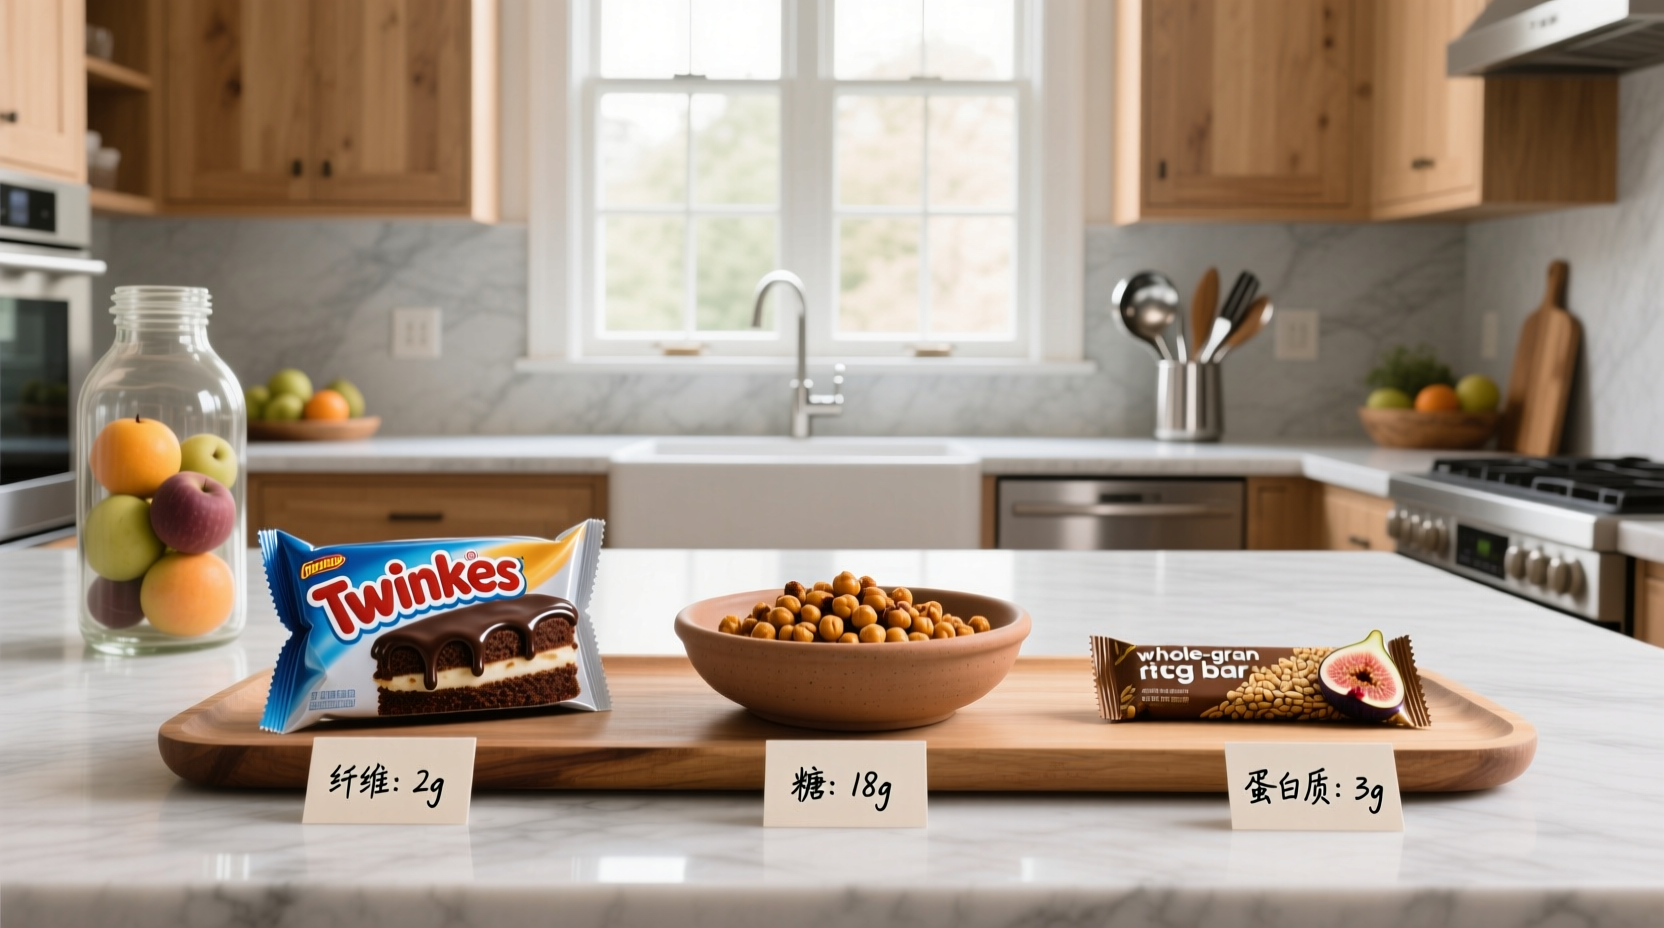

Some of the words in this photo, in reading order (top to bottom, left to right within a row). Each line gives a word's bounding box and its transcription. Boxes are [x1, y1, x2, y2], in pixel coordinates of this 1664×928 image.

[310, 553, 521, 636] Twinkes
[1201, 660, 1249, 679] bar
[412, 769, 445, 808] 2g
[852, 771, 892, 812] 18g
[1354, 776, 1384, 814] 3g
